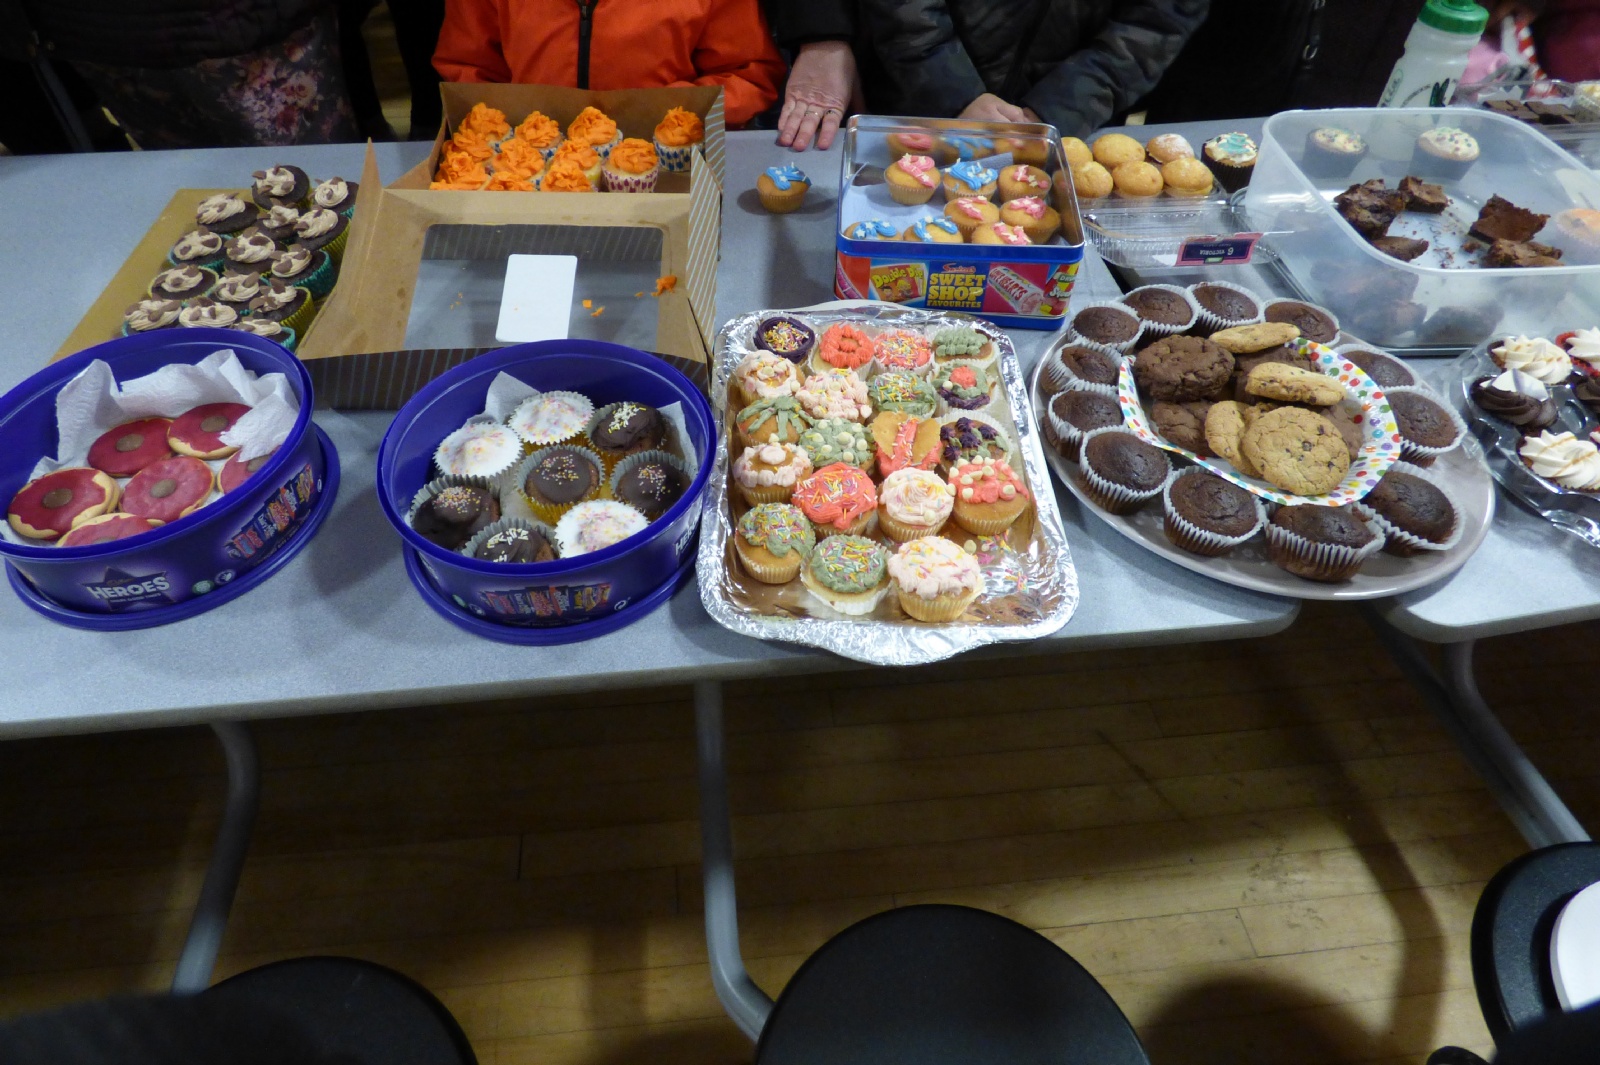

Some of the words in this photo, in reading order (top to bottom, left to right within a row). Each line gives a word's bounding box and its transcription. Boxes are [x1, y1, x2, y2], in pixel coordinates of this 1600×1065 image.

[1227, 247, 1234, 256] 6
[872, 267, 907, 288] Double
[907, 265, 924, 279] Dip
[930, 273, 986, 286] SWEET
[928, 286, 984, 301] SHOP
[927, 300, 982, 308] FAVOURITES
[86, 576, 170, 599] HEROES
